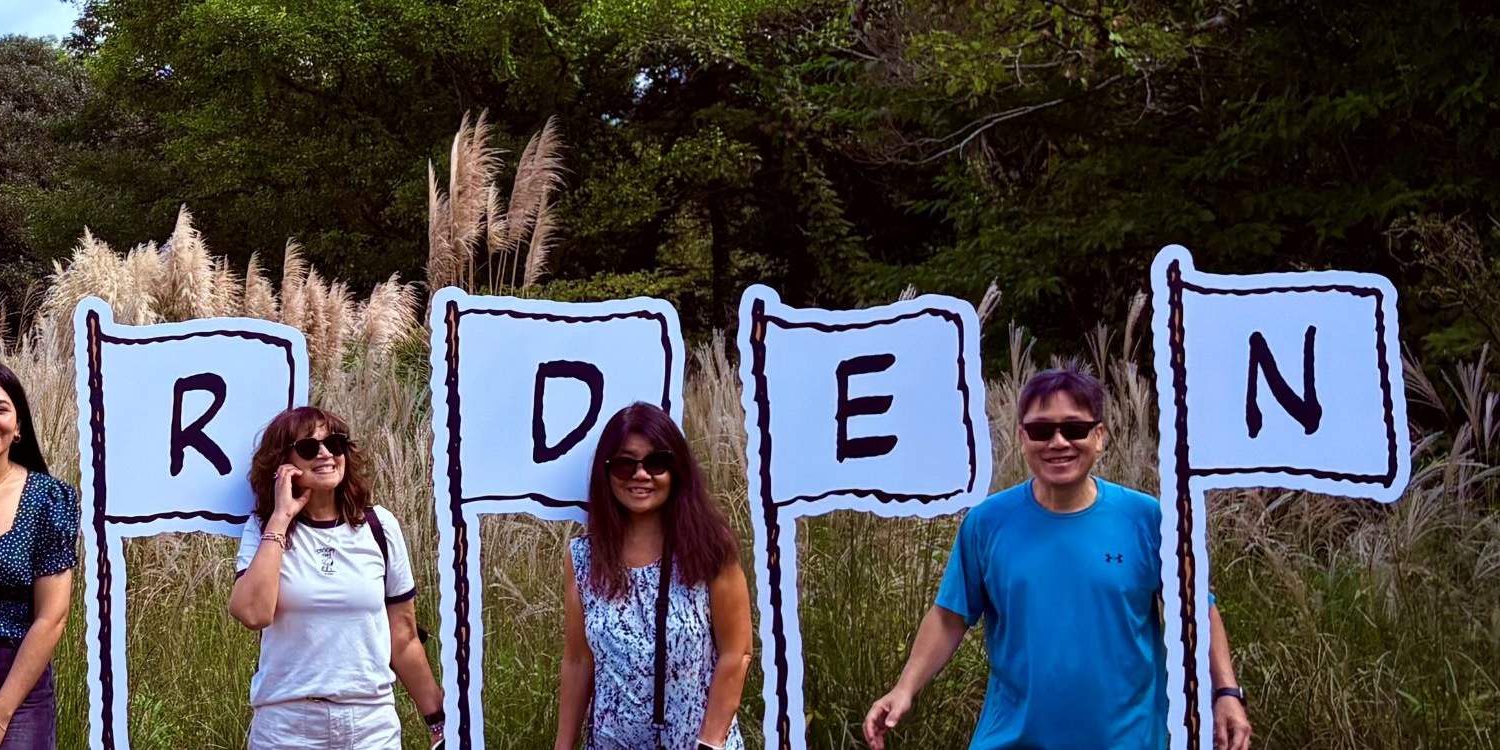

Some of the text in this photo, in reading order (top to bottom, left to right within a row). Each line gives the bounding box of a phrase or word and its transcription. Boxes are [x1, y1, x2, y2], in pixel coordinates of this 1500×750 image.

[170, 372, 232, 476] R
[532, 360, 605, 464] D
[835, 353, 899, 463] E
[1246, 325, 1323, 439] N
